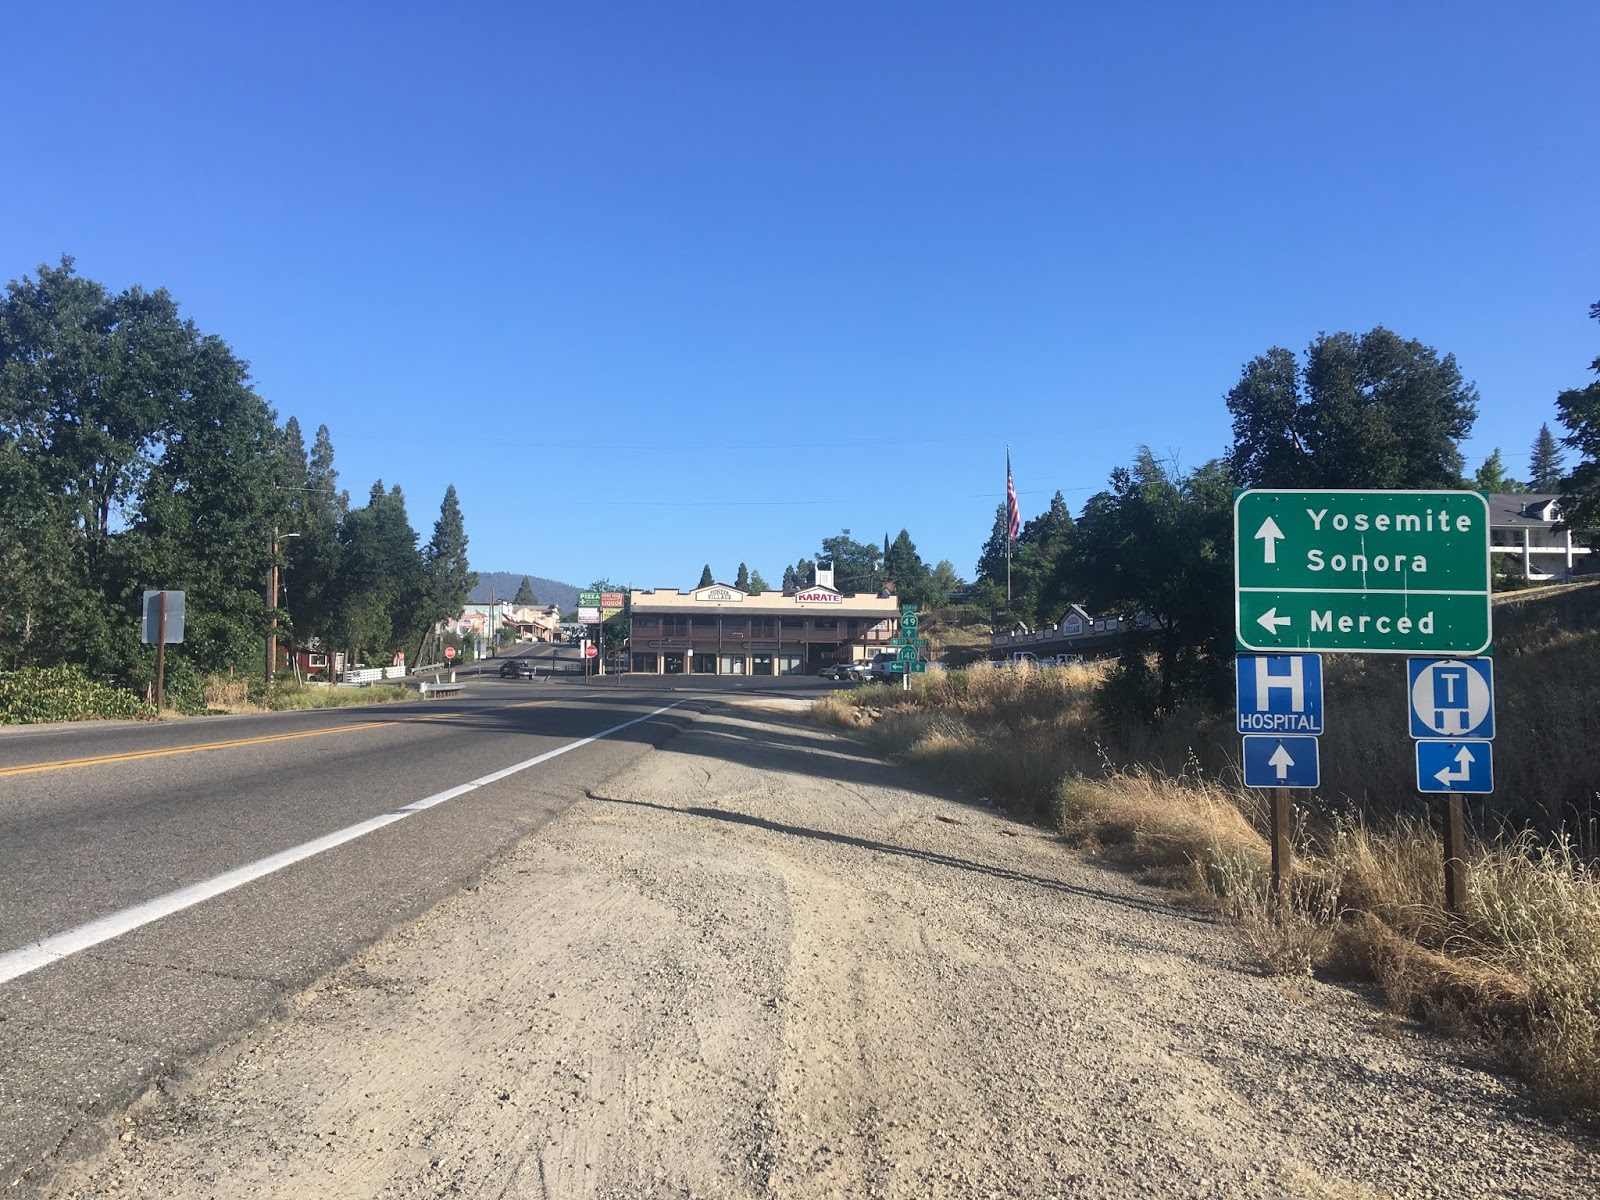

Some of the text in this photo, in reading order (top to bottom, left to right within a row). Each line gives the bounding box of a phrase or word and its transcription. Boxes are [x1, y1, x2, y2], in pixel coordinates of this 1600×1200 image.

[1306, 508, 1472, 533] Yosemite
[1306, 549, 1428, 573] Sonora
[798, 593, 841, 602] KARATE
[903, 618, 916, 626] 49
[1310, 610, 1434, 634] Merced
[900, 651, 916, 660] 140
[1254, 656, 1305, 713] H
[1441, 673, 1460, 703] T
[1240, 714, 1321, 730] HOSPITAL
